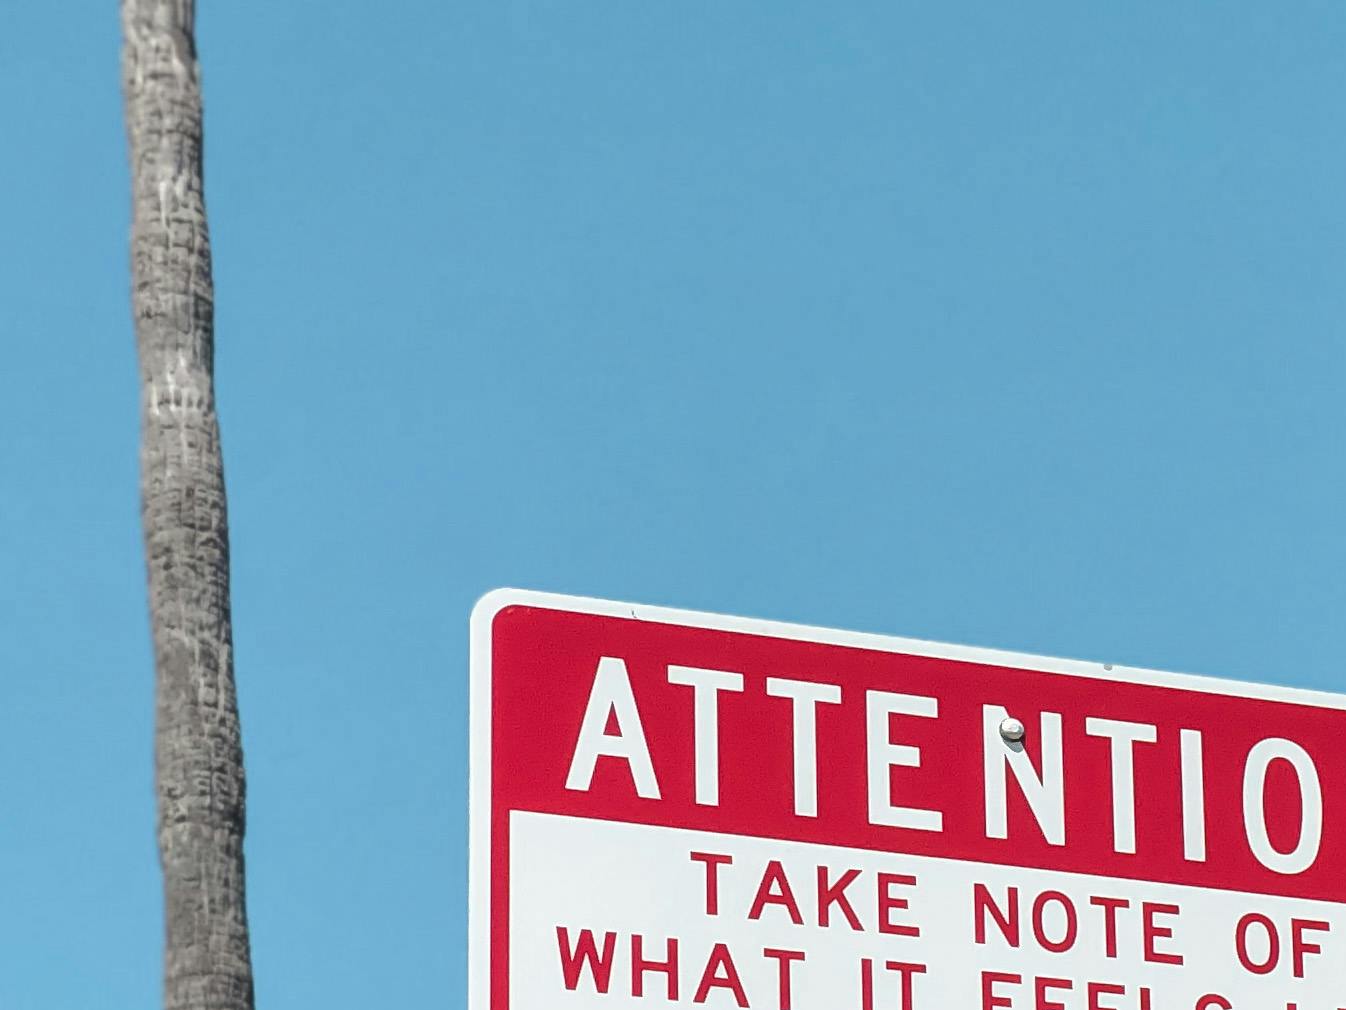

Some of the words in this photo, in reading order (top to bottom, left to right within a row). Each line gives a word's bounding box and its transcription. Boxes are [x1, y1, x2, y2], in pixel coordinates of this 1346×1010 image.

[690, 851, 921, 937] TAKE
[973, 883, 1185, 965] NOTE
[1235, 912, 1330, 978] OF
